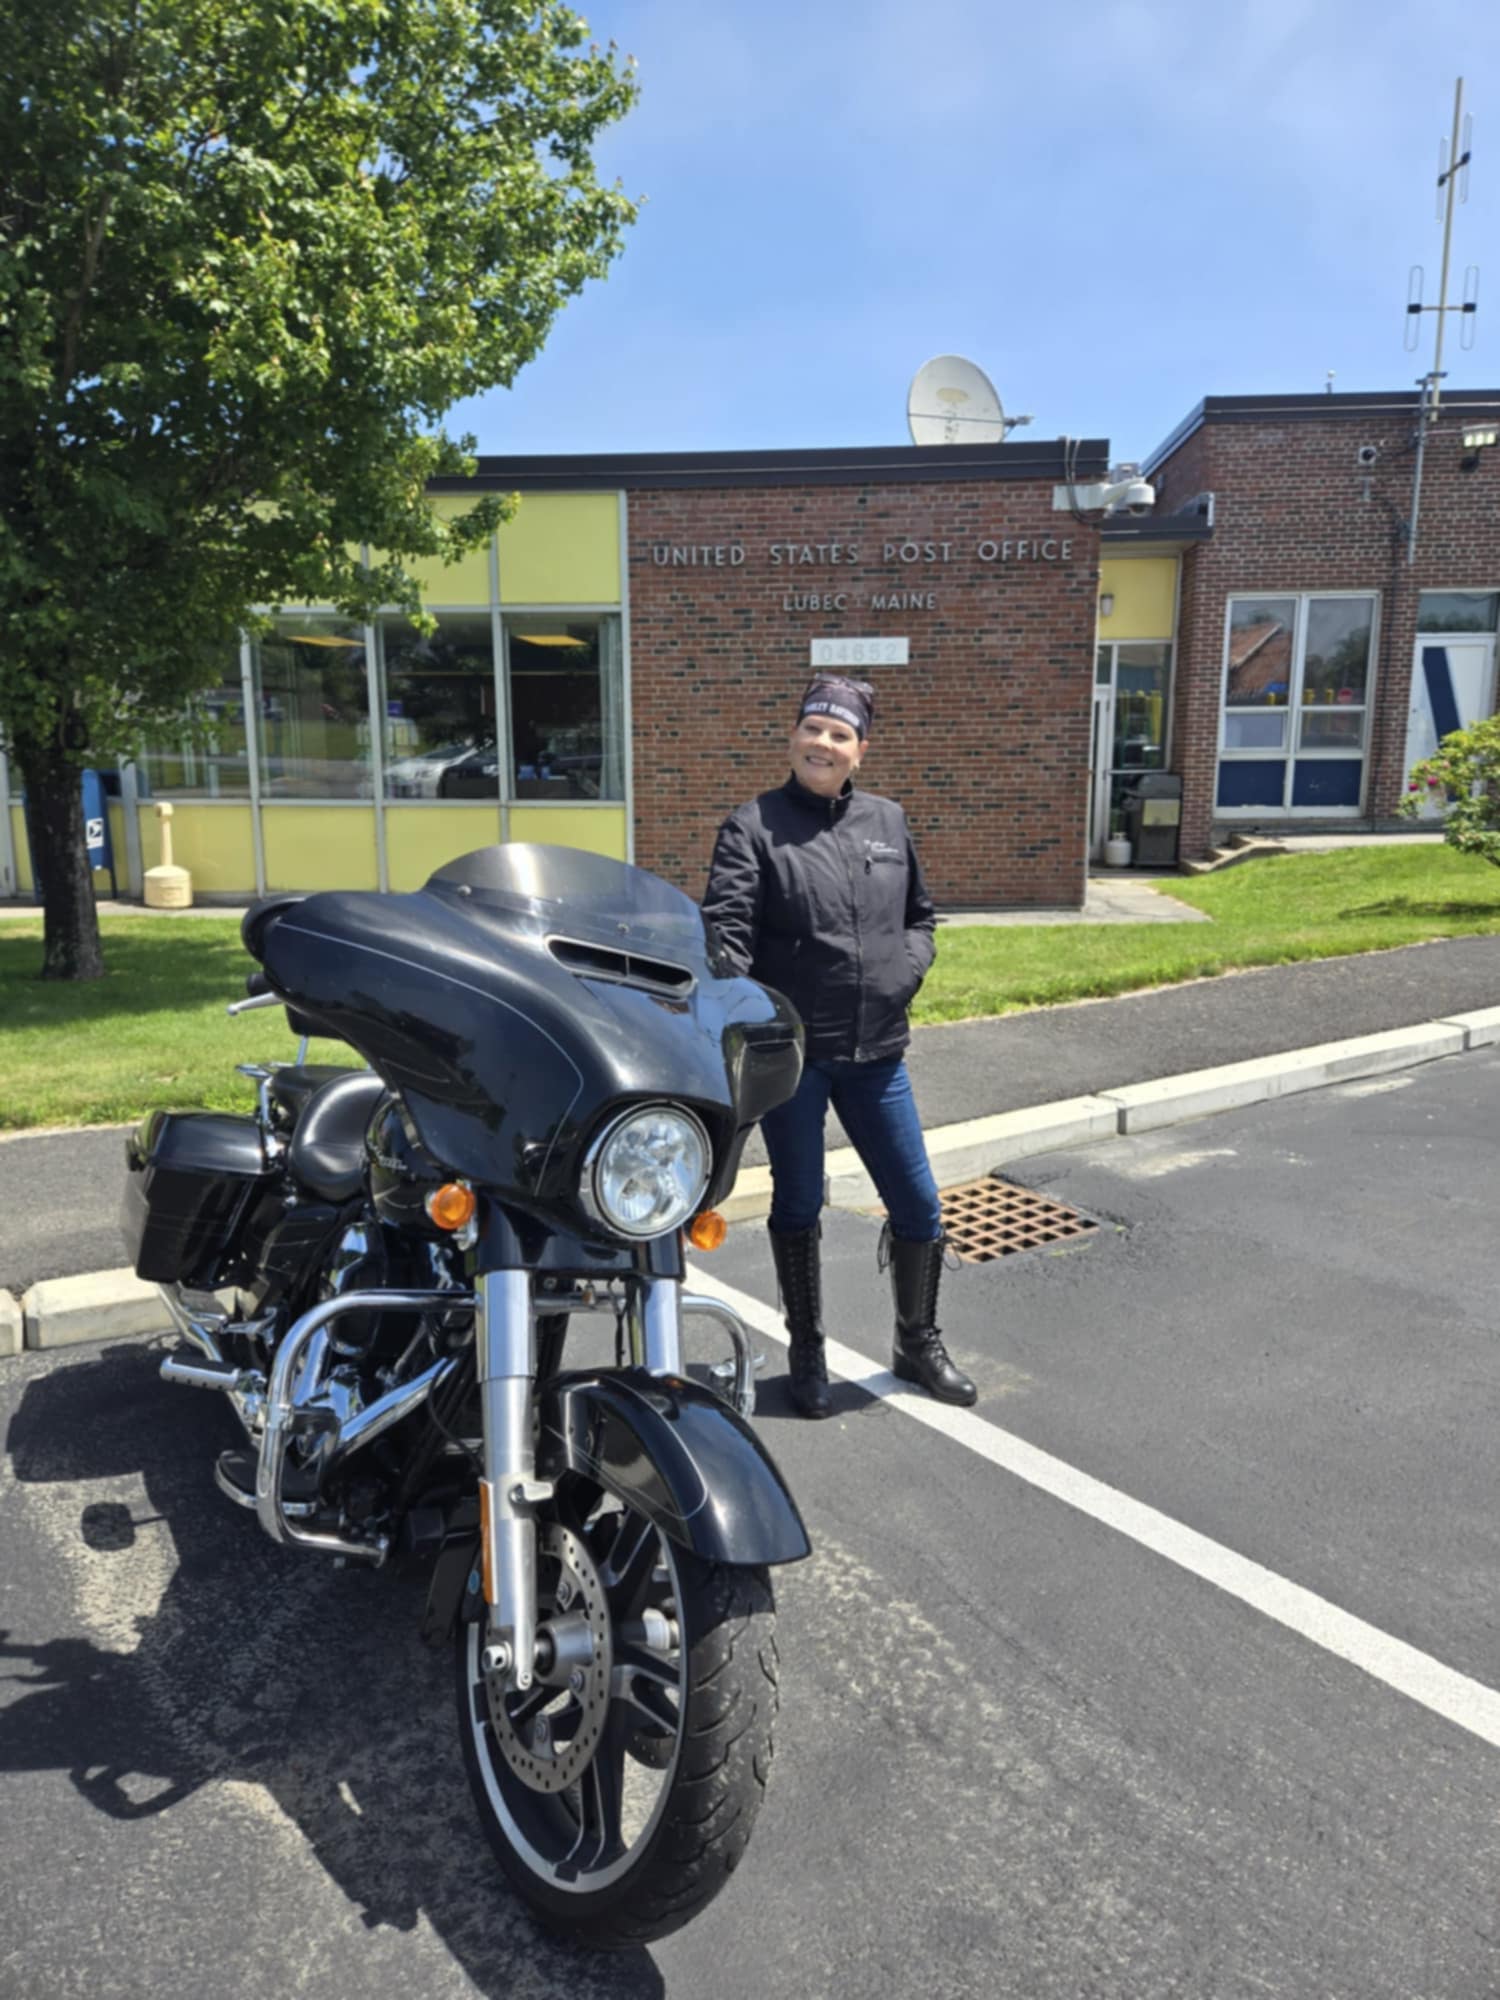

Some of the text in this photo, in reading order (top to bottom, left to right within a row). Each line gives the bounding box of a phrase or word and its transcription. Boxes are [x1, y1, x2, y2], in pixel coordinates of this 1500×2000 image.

[653, 539, 1073, 566] UNITED STATES POST OFFICE
[782, 592, 937, 611] LUBEC MAINE
[818, 642, 898, 662] 04652
